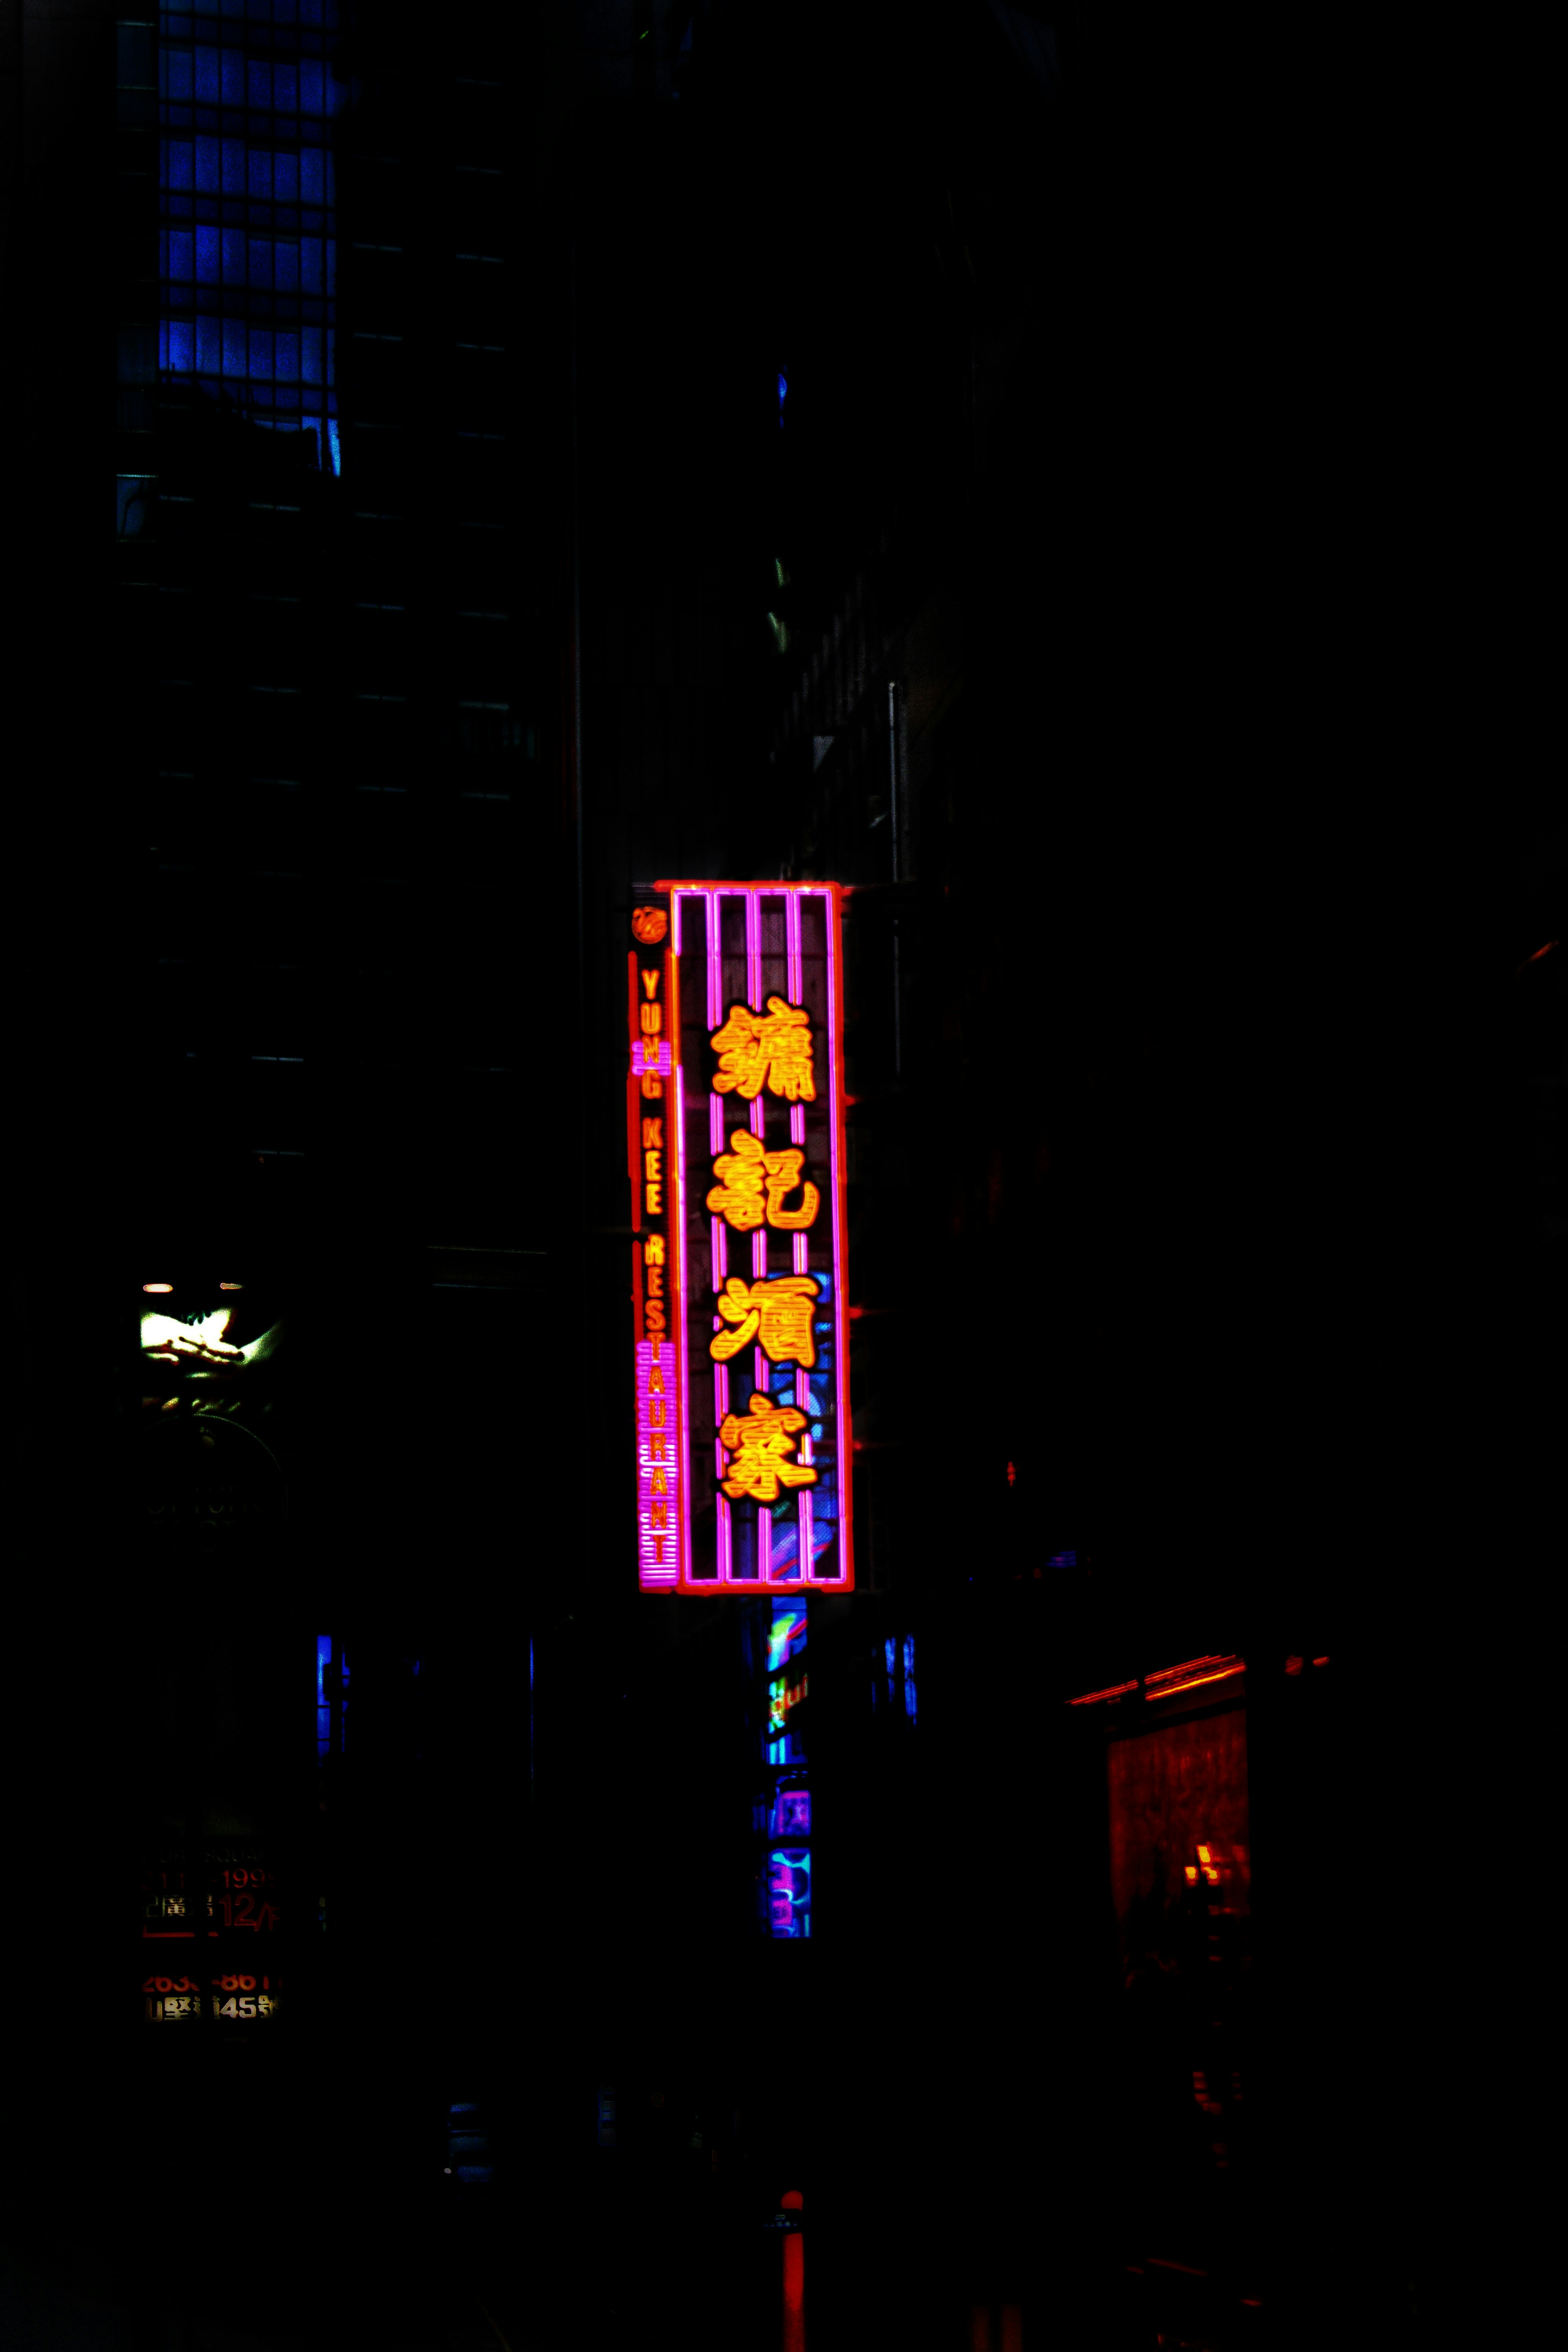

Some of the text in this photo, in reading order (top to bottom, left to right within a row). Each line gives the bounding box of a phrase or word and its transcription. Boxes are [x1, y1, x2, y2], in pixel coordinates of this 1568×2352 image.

[641, 969, 668, 1563] YUNG KEE RESTAURANT
